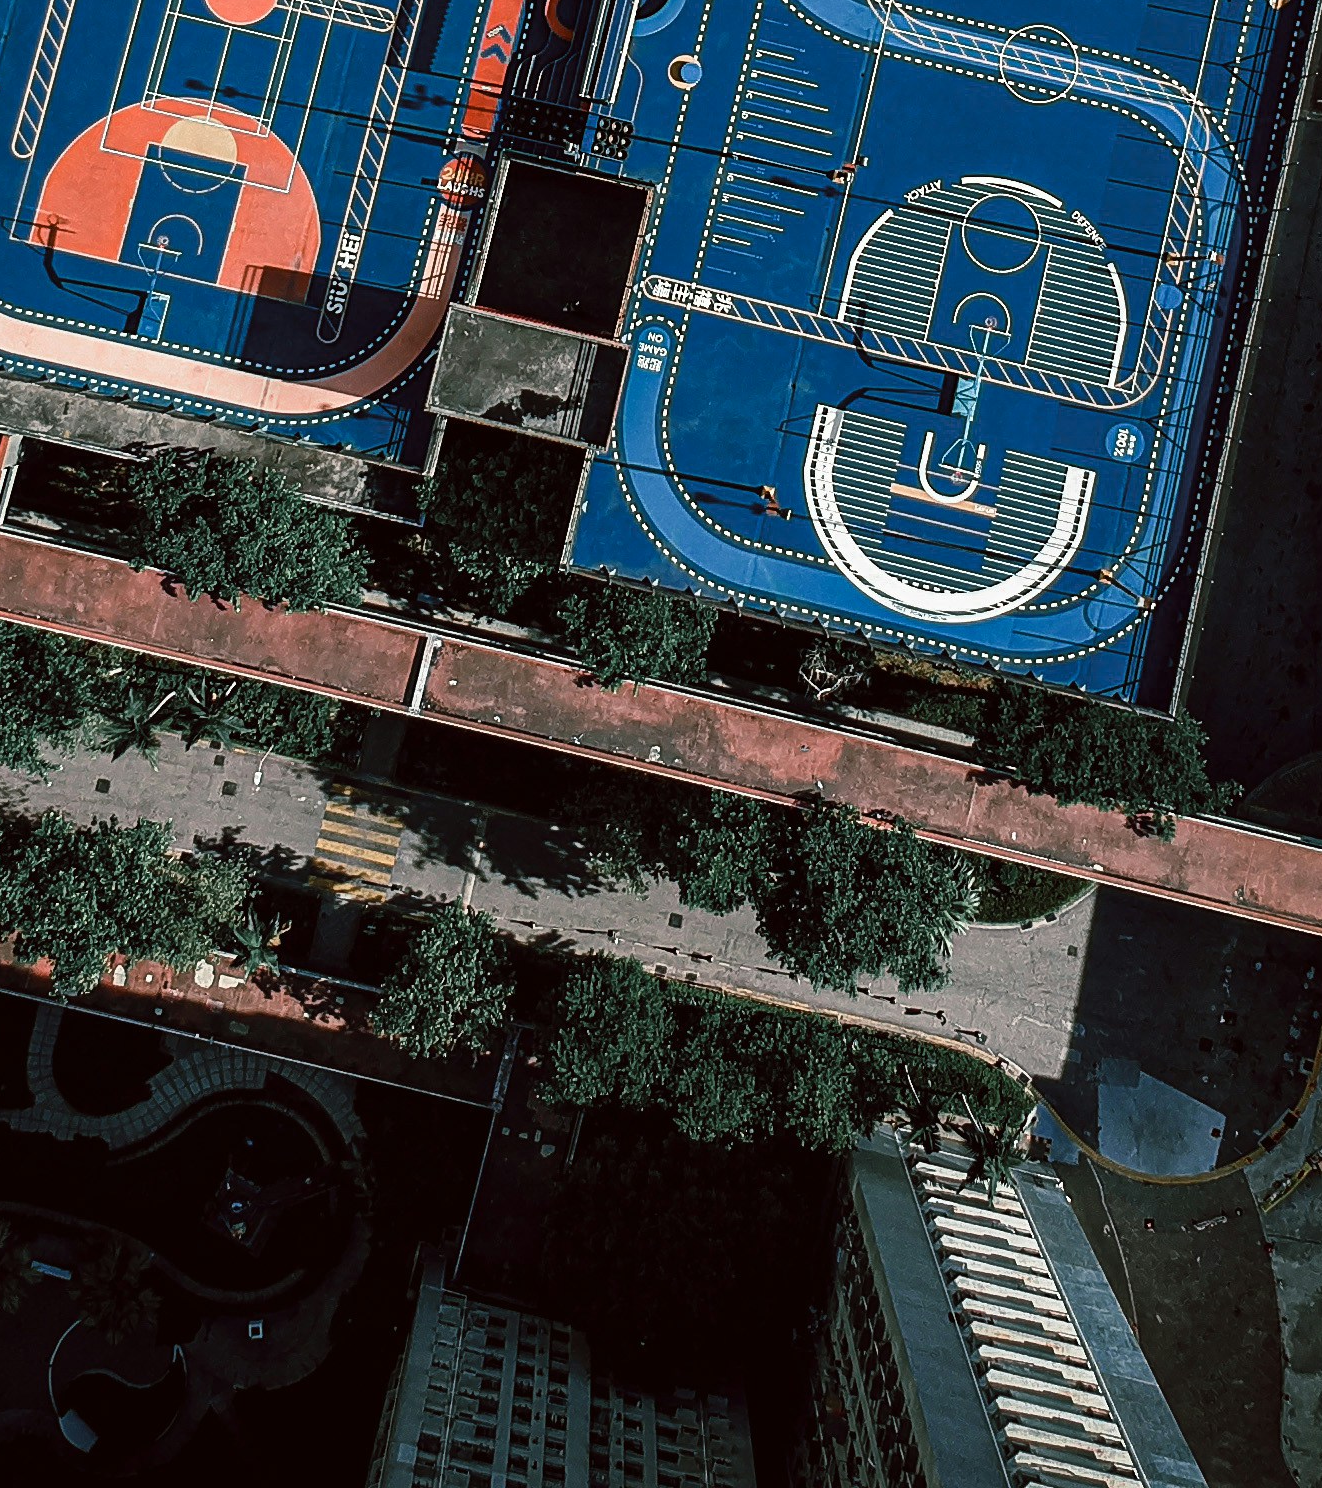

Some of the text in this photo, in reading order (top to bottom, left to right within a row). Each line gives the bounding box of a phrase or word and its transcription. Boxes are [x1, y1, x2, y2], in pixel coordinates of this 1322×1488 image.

[437, 177, 485, 198] LAUGHS
[903, 179, 941, 202] ATTACK
[1070, 210, 1107, 251] DEFENCE
[647, 331, 663, 343] ON
[637, 341, 667, 356] GAME
[1113, 428, 1129, 456] 100%
